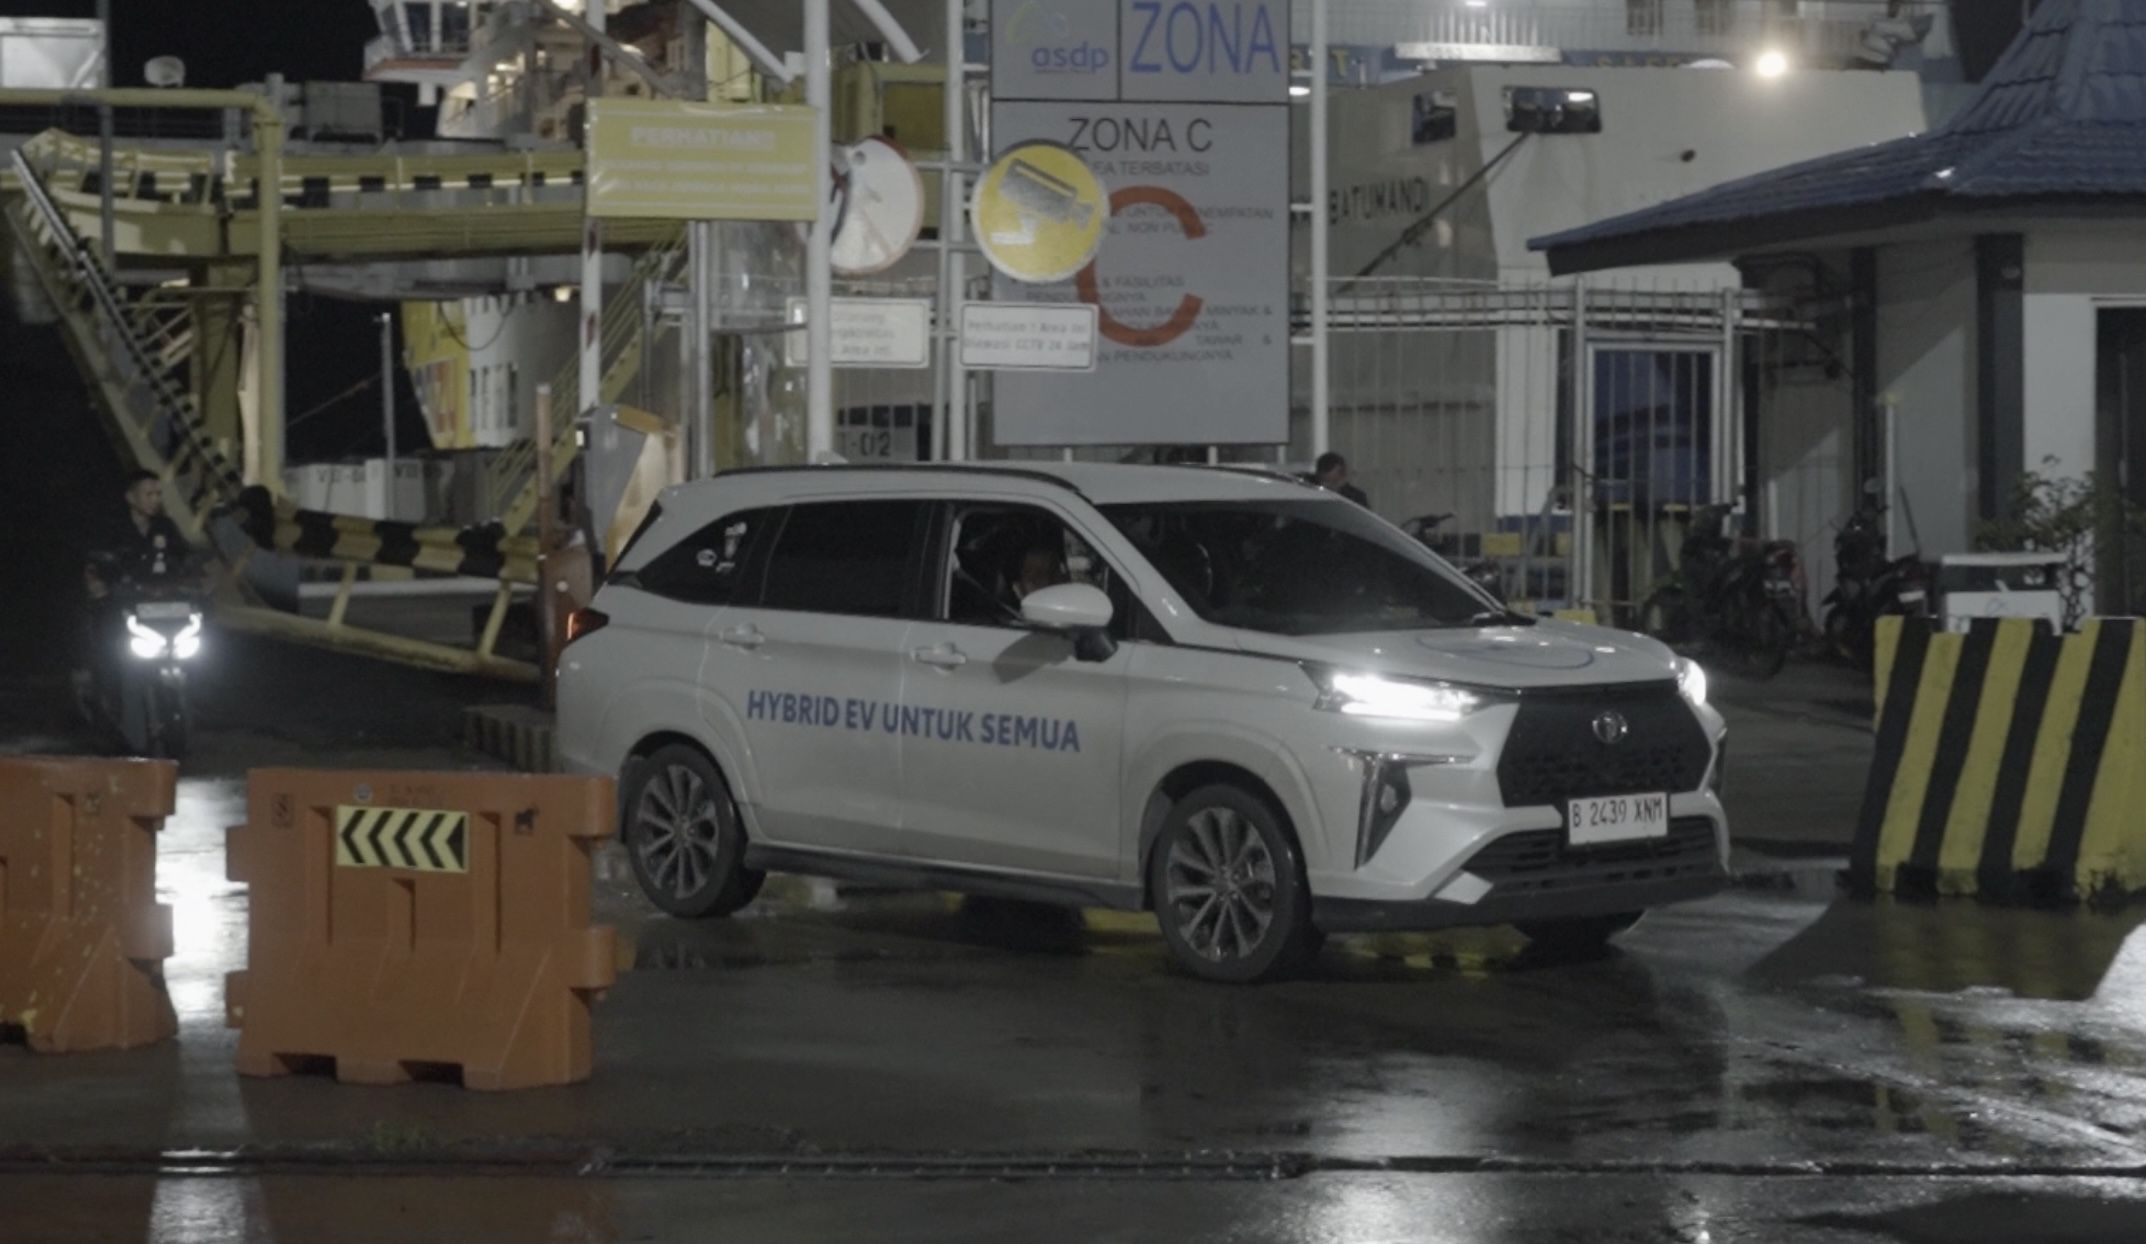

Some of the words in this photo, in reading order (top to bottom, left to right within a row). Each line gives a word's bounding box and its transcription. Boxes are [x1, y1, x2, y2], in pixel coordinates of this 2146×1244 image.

[1130, 3, 1281, 74] ZONA
[1031, 41, 1109, 74] asdp
[1066, 118, 1176, 151] ZONA
[1187, 118, 1213, 152] C
[1119, 160, 1209, 176] TERBATASI
[748, 690, 840, 727] HYBRID
[846, 700, 876, 731] EV
[883, 704, 974, 742] UNTUK
[981, 713, 1081, 752] SEMUA
[1572, 803, 1582, 828] B
[1590, 799, 1627, 826] 2439
